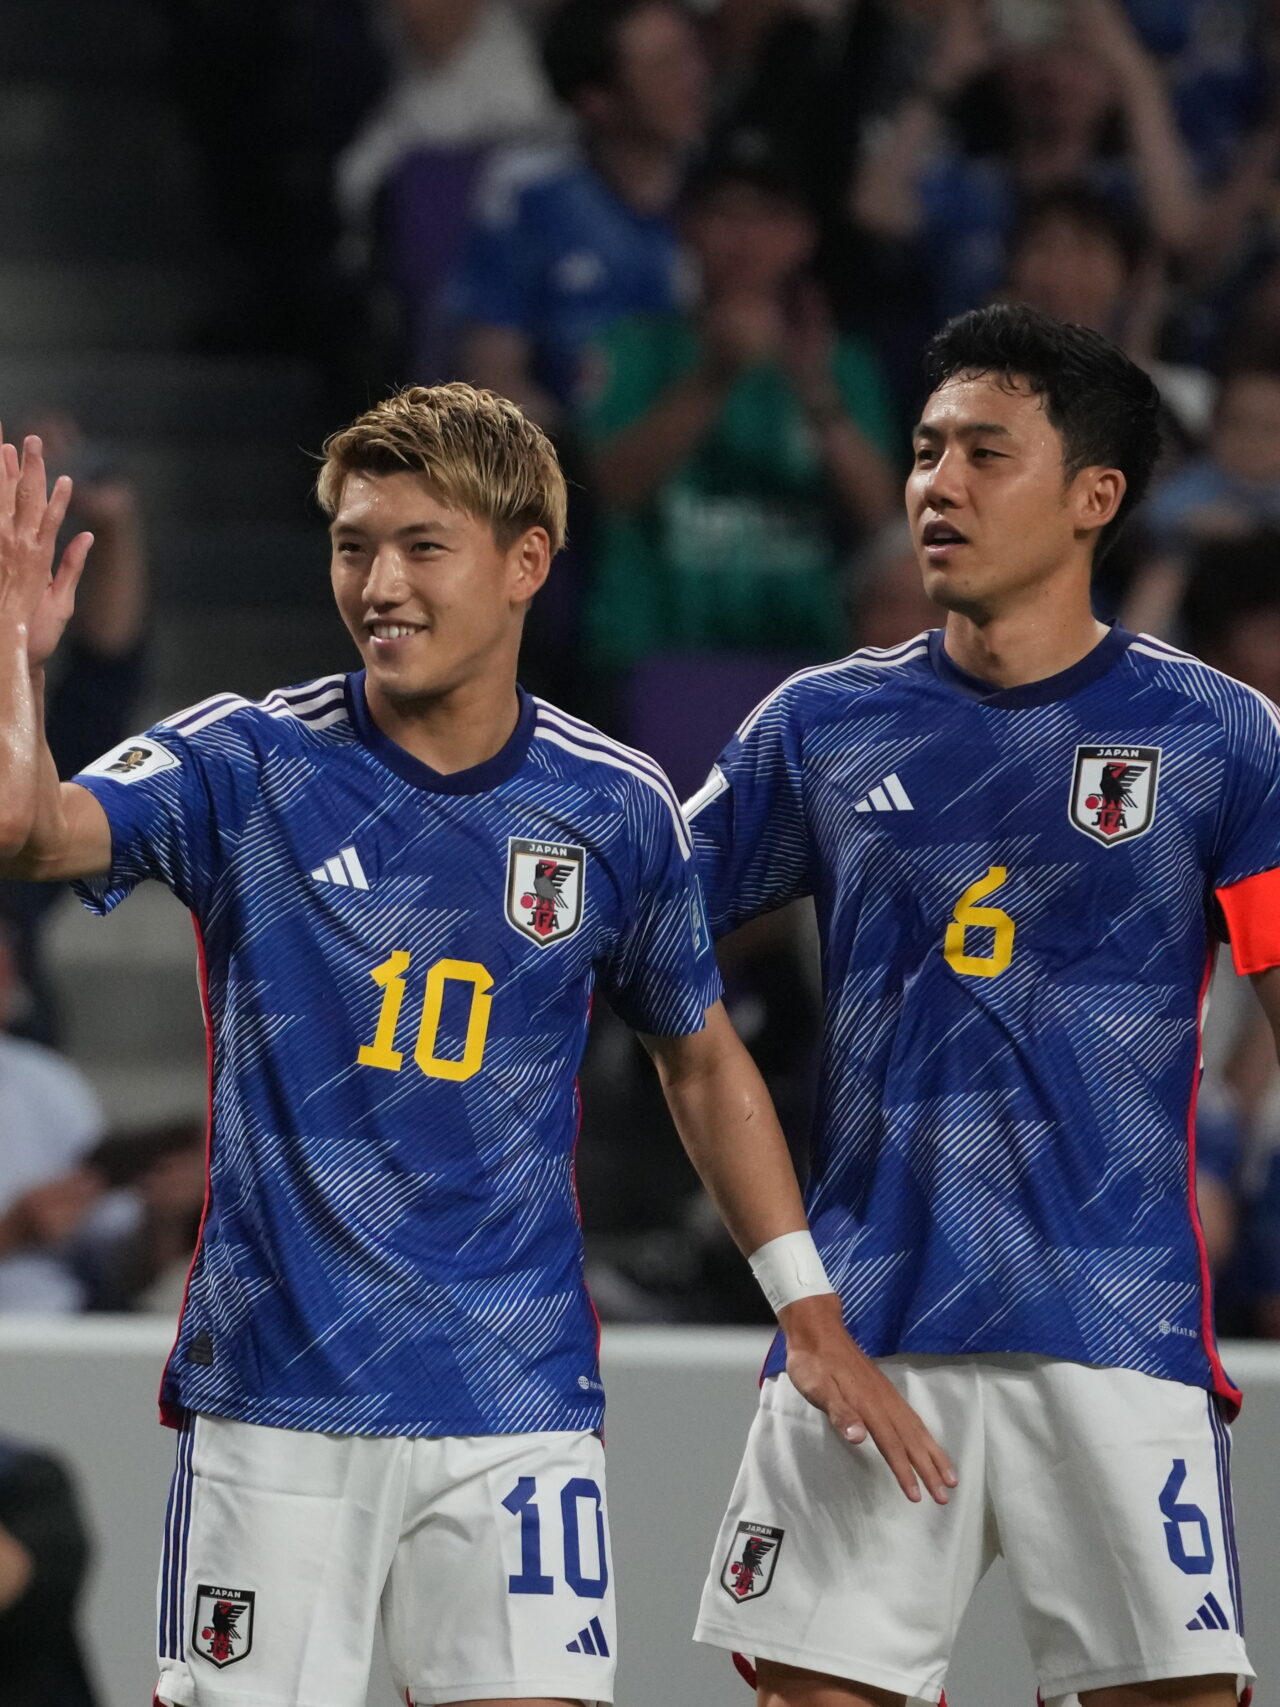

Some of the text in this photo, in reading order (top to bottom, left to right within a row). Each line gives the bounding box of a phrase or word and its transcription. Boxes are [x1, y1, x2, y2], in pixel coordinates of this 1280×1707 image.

[1096, 748, 1140, 758] JAPAN
[1091, 811, 1128, 829] JFA
[529, 844, 568, 856] JAPAN
[526, 911, 560, 930] JFA
[943, 865, 1016, 978] 6
[357, 949, 494, 1081] 10
[1158, 1459, 1213, 1575] 6
[501, 1476, 608, 1599] 10
[746, 1524, 773, 1535] JAPAN
[209, 1588, 241, 1598] JAPAN
